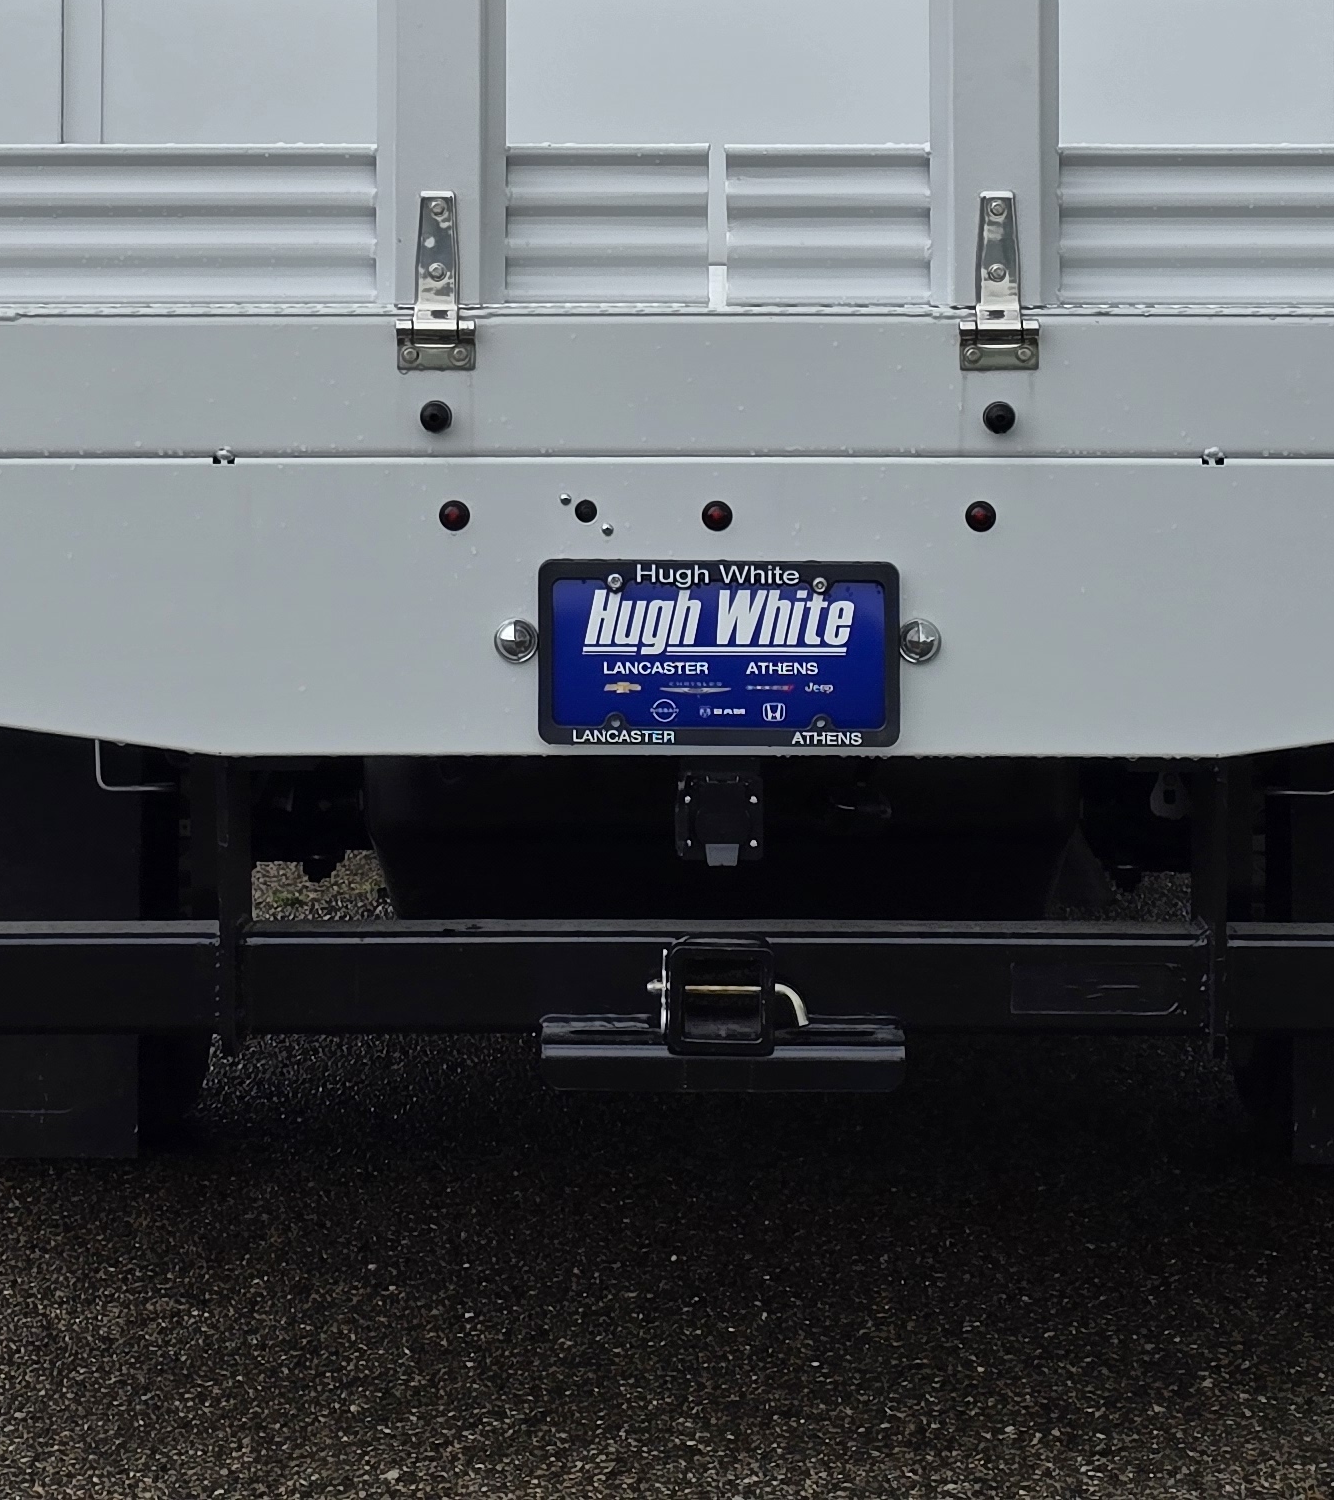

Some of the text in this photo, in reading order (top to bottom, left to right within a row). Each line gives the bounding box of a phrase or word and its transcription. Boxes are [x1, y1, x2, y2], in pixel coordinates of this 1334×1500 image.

[636, 564, 800, 588] Hugh White
[584, 589, 855, 655] Hugh White
[603, 661, 819, 675] LANCASTER ATHENS
[572, 729, 675, 744] LANCASTER
[791, 731, 863, 746] ATHENS
